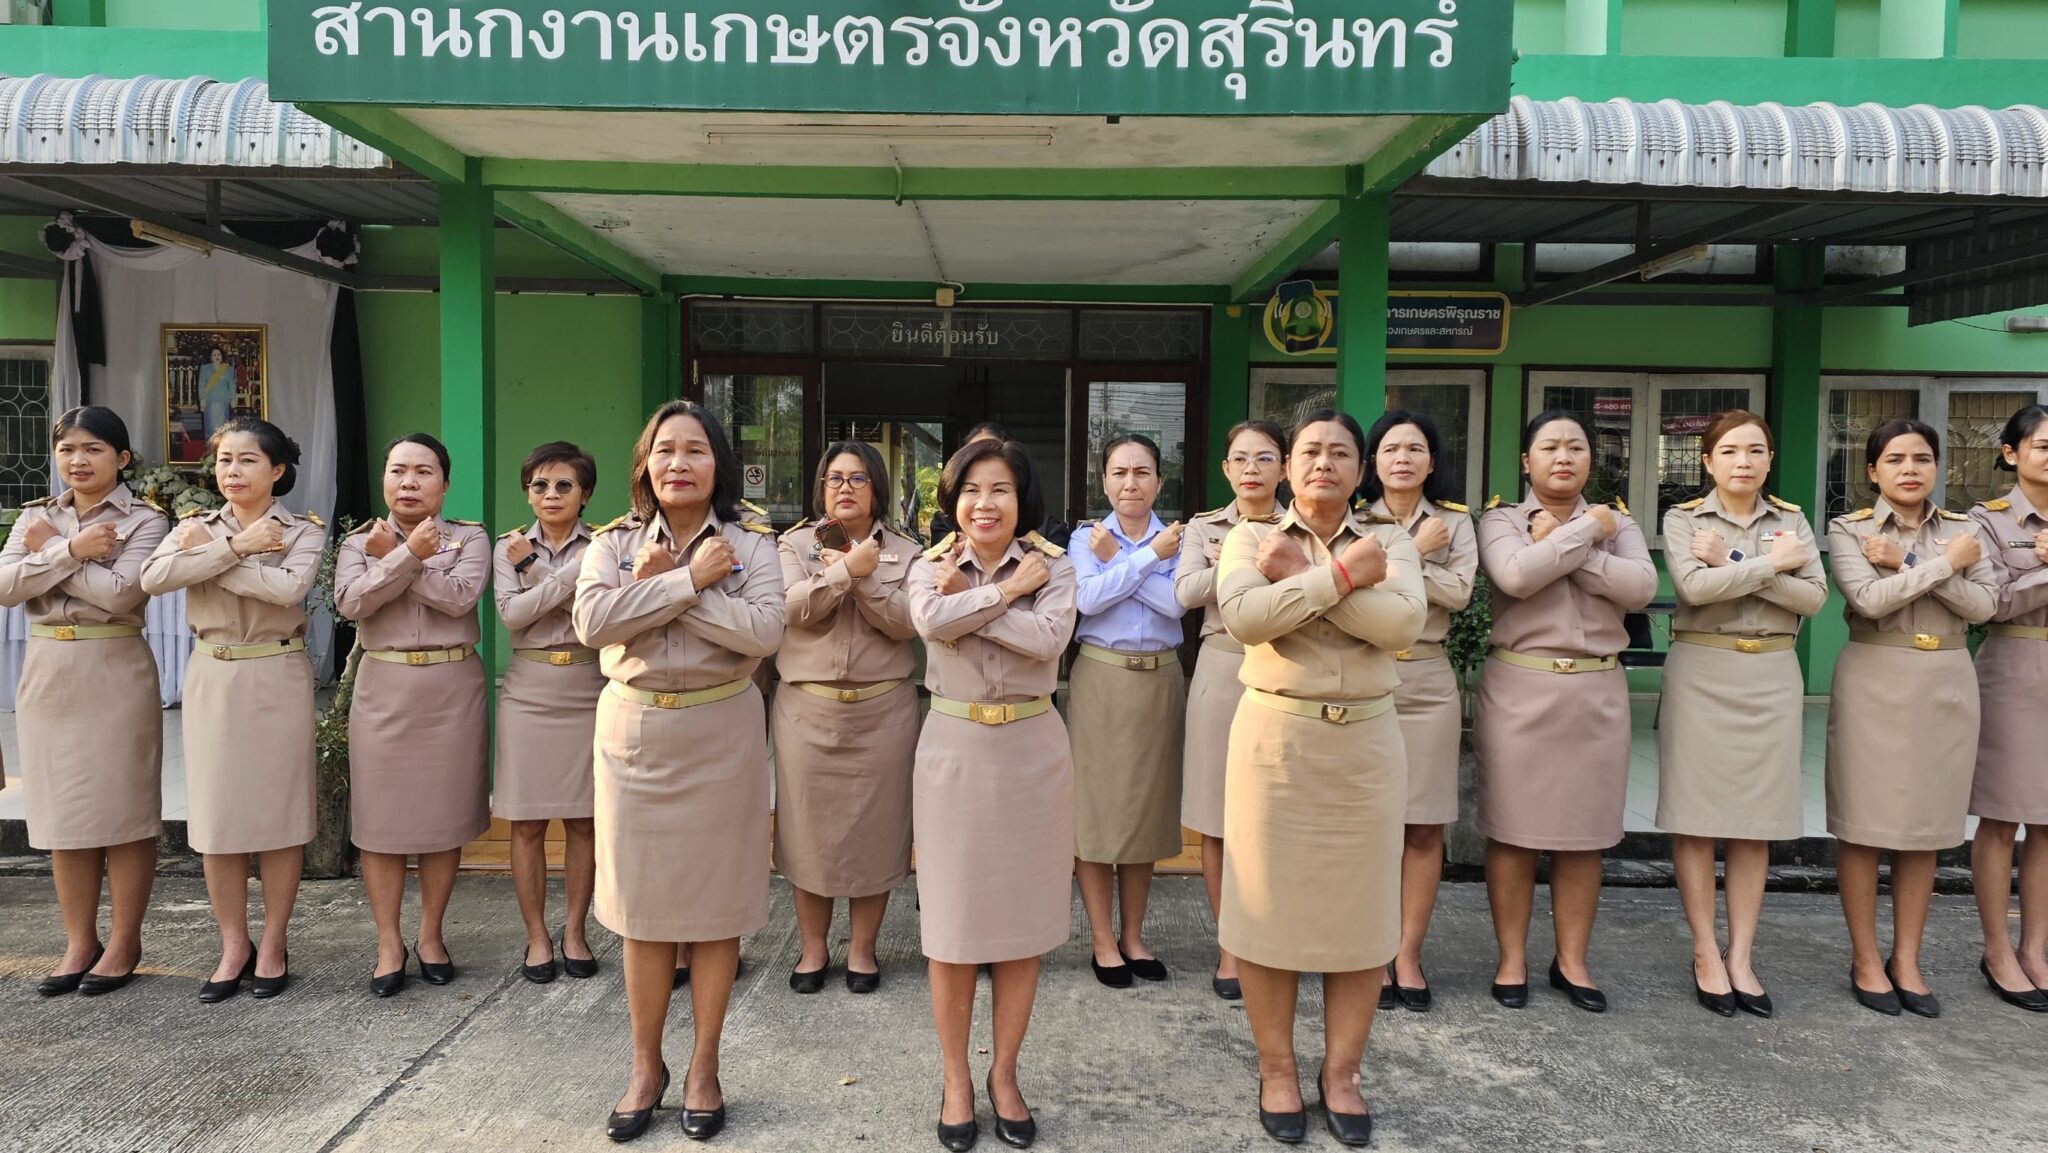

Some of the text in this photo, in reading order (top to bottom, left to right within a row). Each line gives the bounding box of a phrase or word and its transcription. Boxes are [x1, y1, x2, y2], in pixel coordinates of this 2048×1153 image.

[892, 321, 999, 345] ยินดีต้อนรับ
[1386, 325, 1473, 336] วงเกษตรและสหกรณ์
